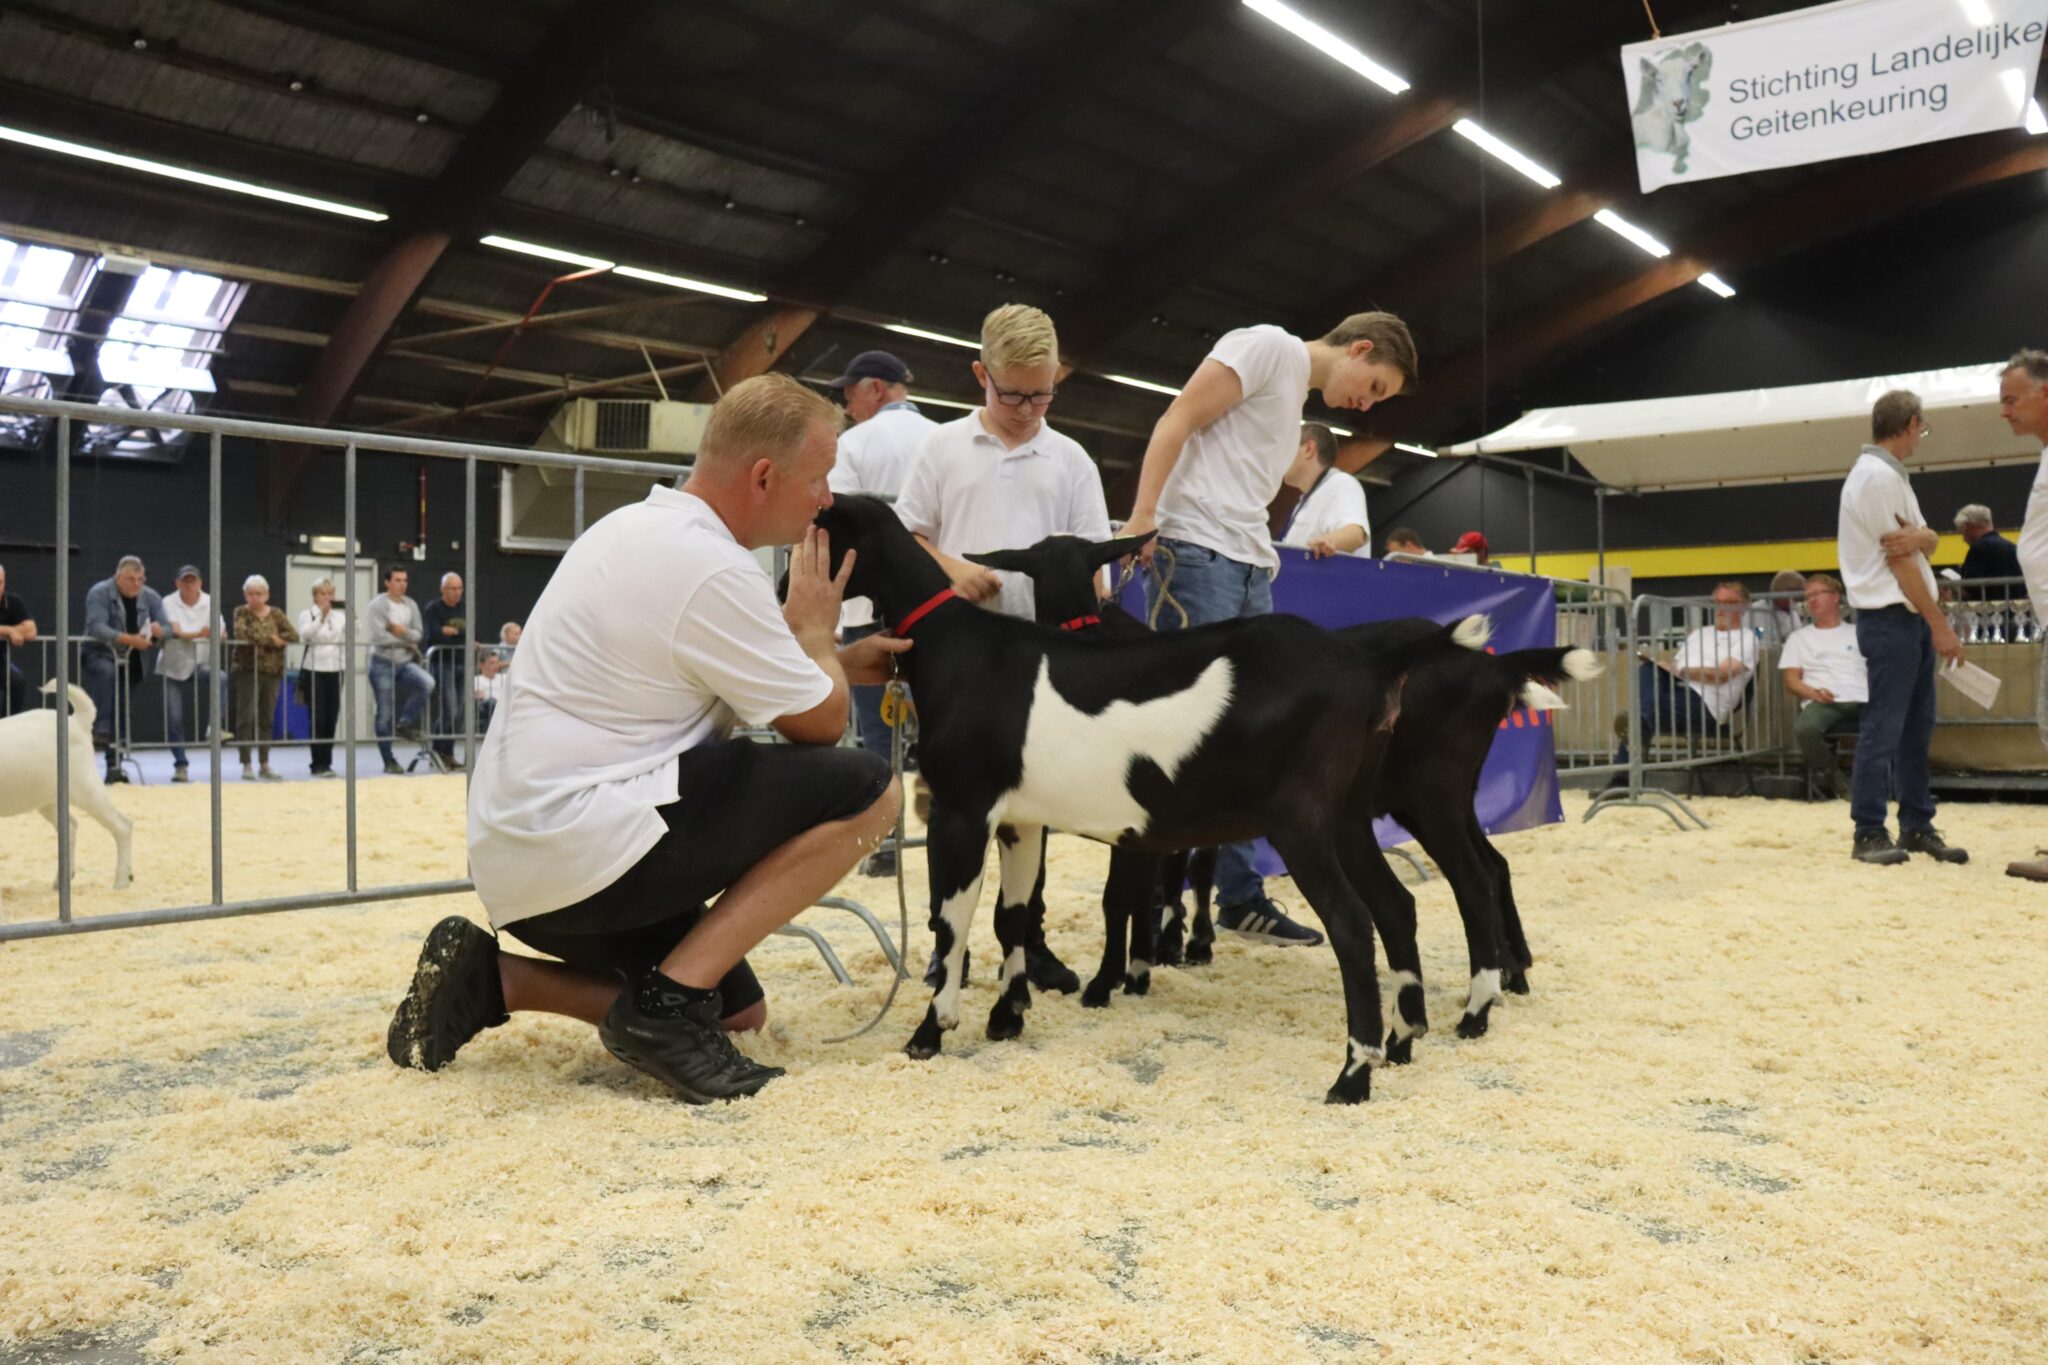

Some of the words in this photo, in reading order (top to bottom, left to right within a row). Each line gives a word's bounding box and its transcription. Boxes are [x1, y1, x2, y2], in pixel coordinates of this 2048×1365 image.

[1730, 61, 1859, 104] Stichting
[1871, 21, 2044, 76] Landelijke
[1730, 83, 1948, 141] Geitenkeuring
